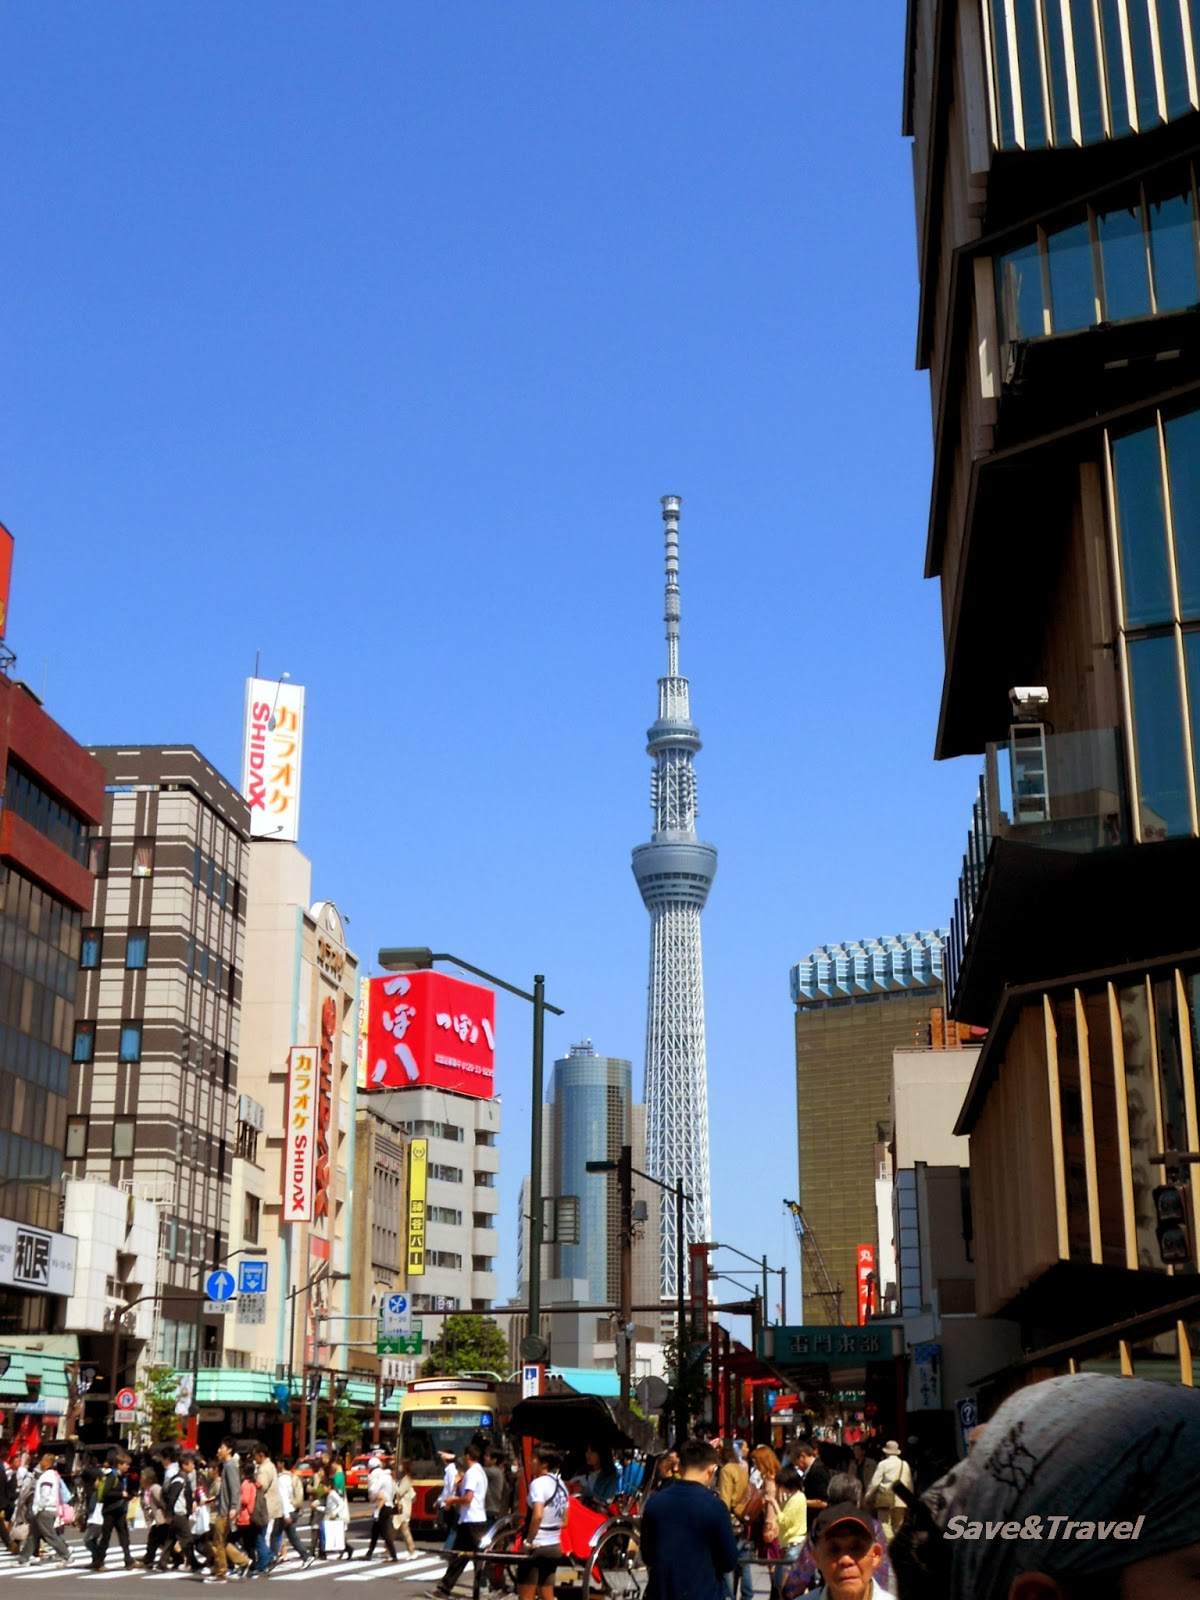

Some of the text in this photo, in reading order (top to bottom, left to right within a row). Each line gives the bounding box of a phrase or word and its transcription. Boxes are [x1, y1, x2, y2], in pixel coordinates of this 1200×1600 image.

[247, 701, 270, 811] SHIDAX
[268, 704, 298, 815] カラオケ
[371, 976, 420, 1083] つぼ八
[435, 1012, 495, 1051] つぼ八
[292, 1054, 312, 1212] カラオケ SHIDAX
[411, 1200, 424, 1266] 神谷バー
[788, 1333, 880, 1355] 雷門東部
